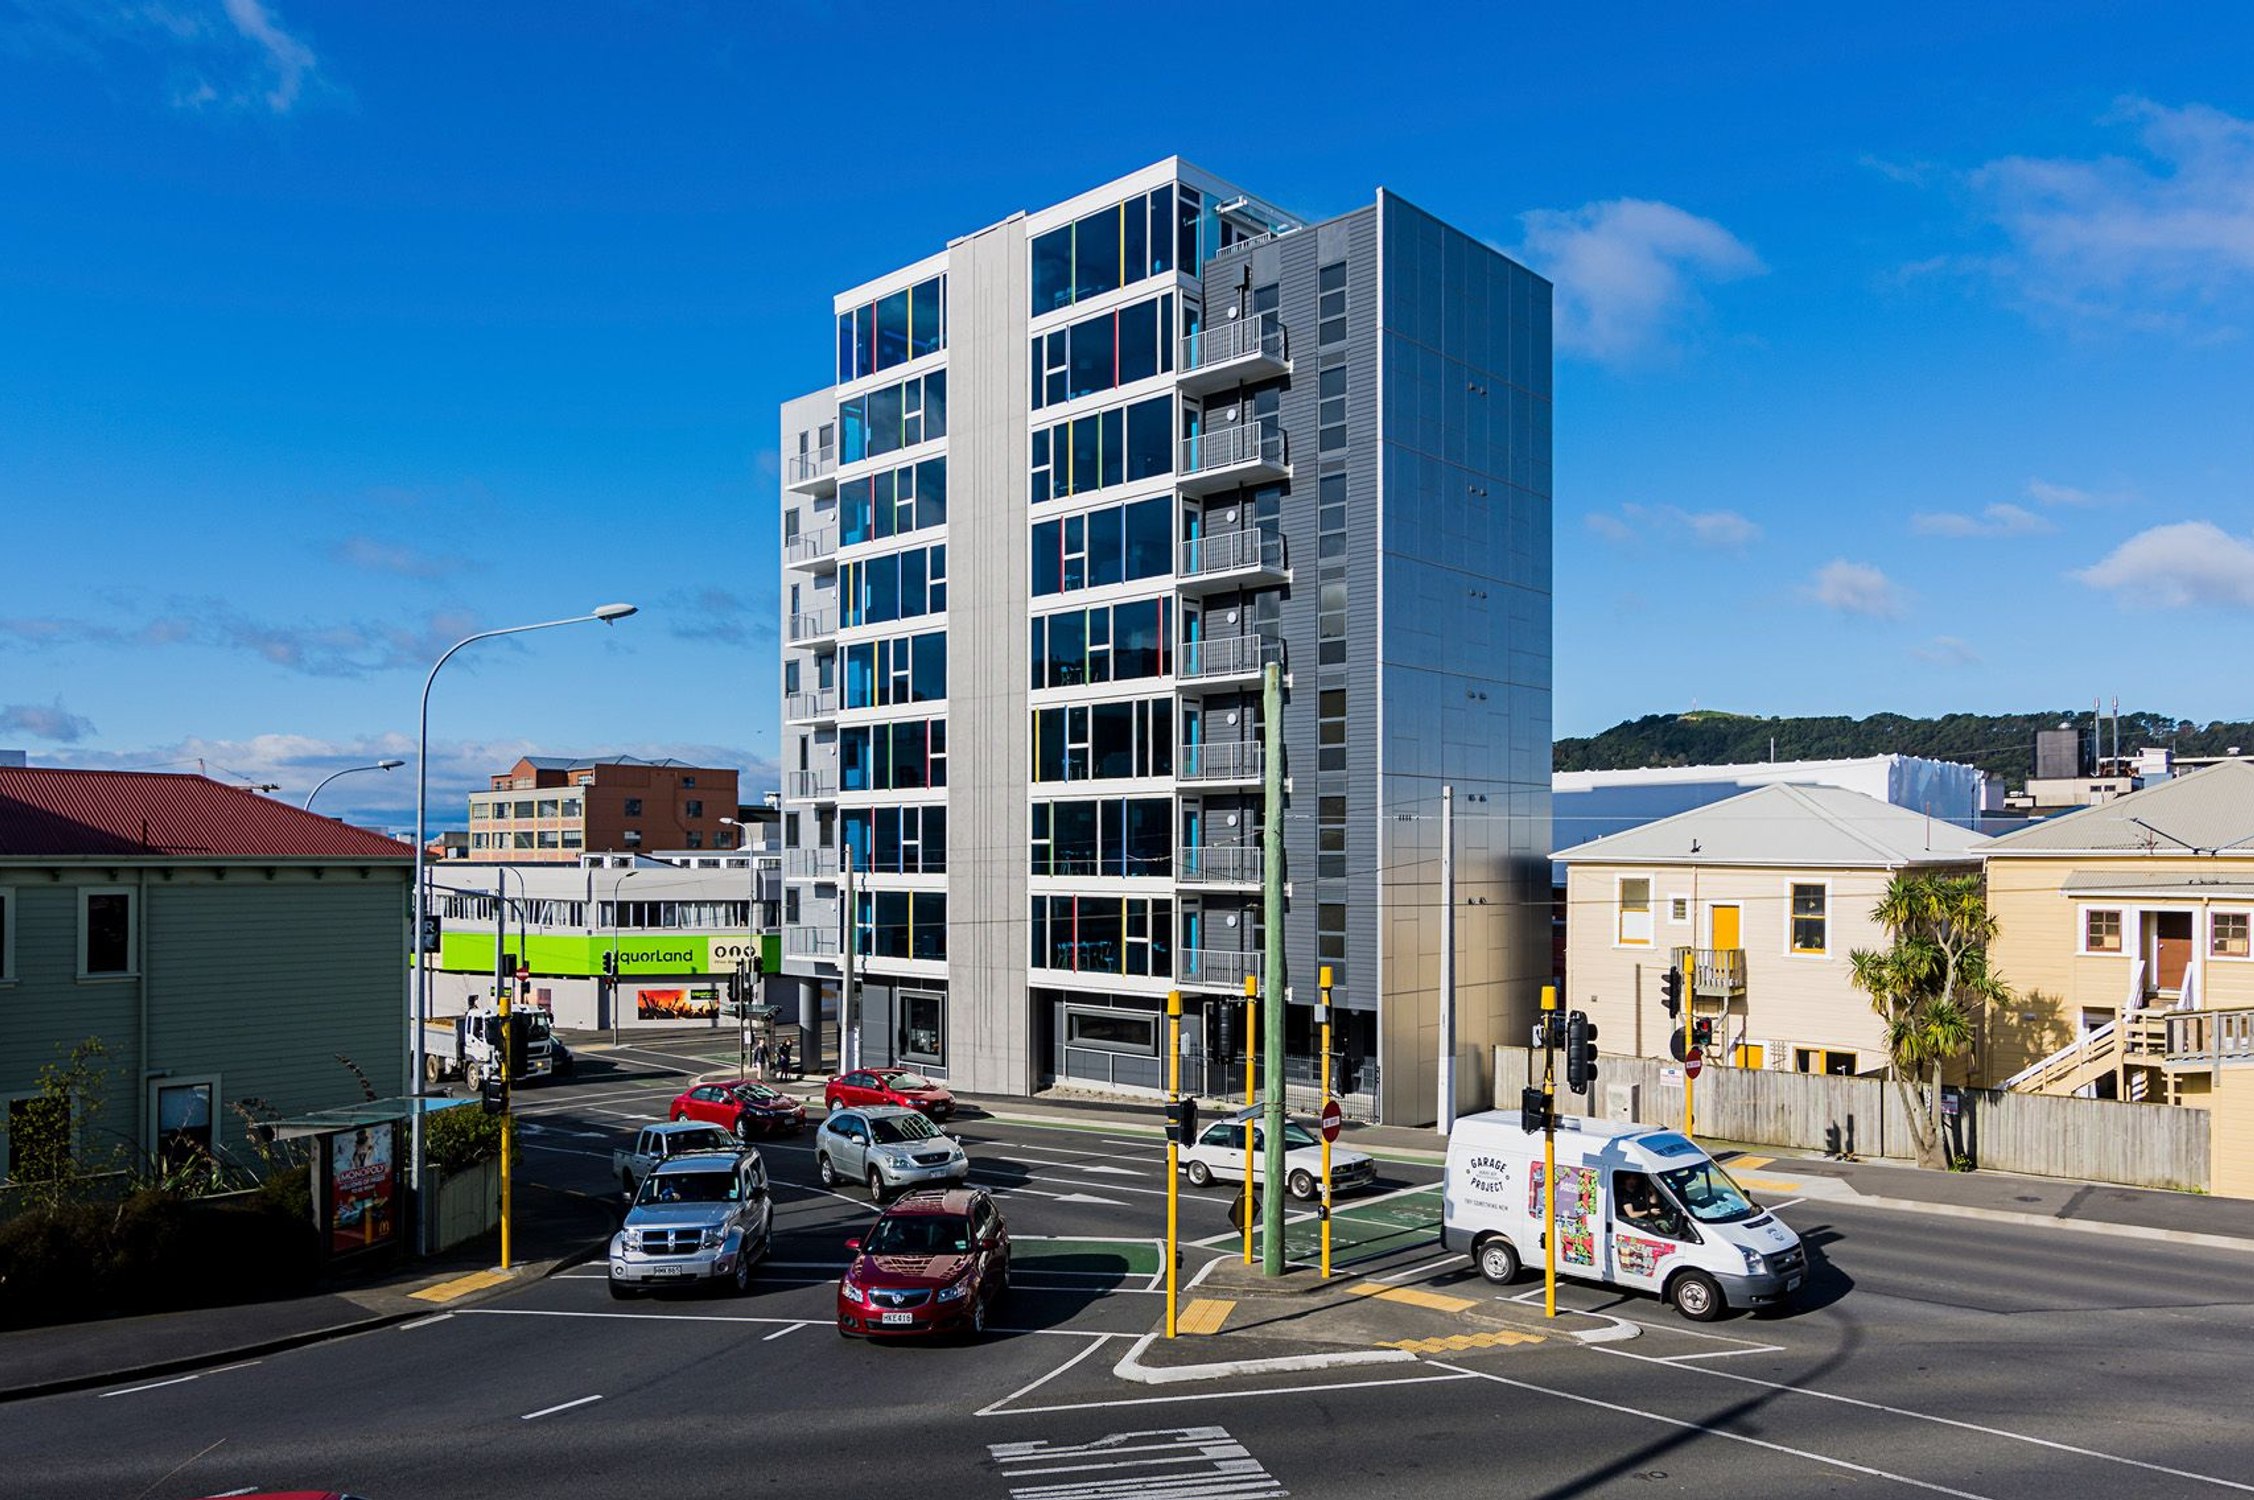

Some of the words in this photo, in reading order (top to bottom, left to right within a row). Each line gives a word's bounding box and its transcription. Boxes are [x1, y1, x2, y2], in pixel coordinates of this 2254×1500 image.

[341, 1164, 385, 1180] MONOPOLY
[1470, 1156, 1507, 1173] GARAGE
[1470, 1177, 1503, 1192] PROJECT
